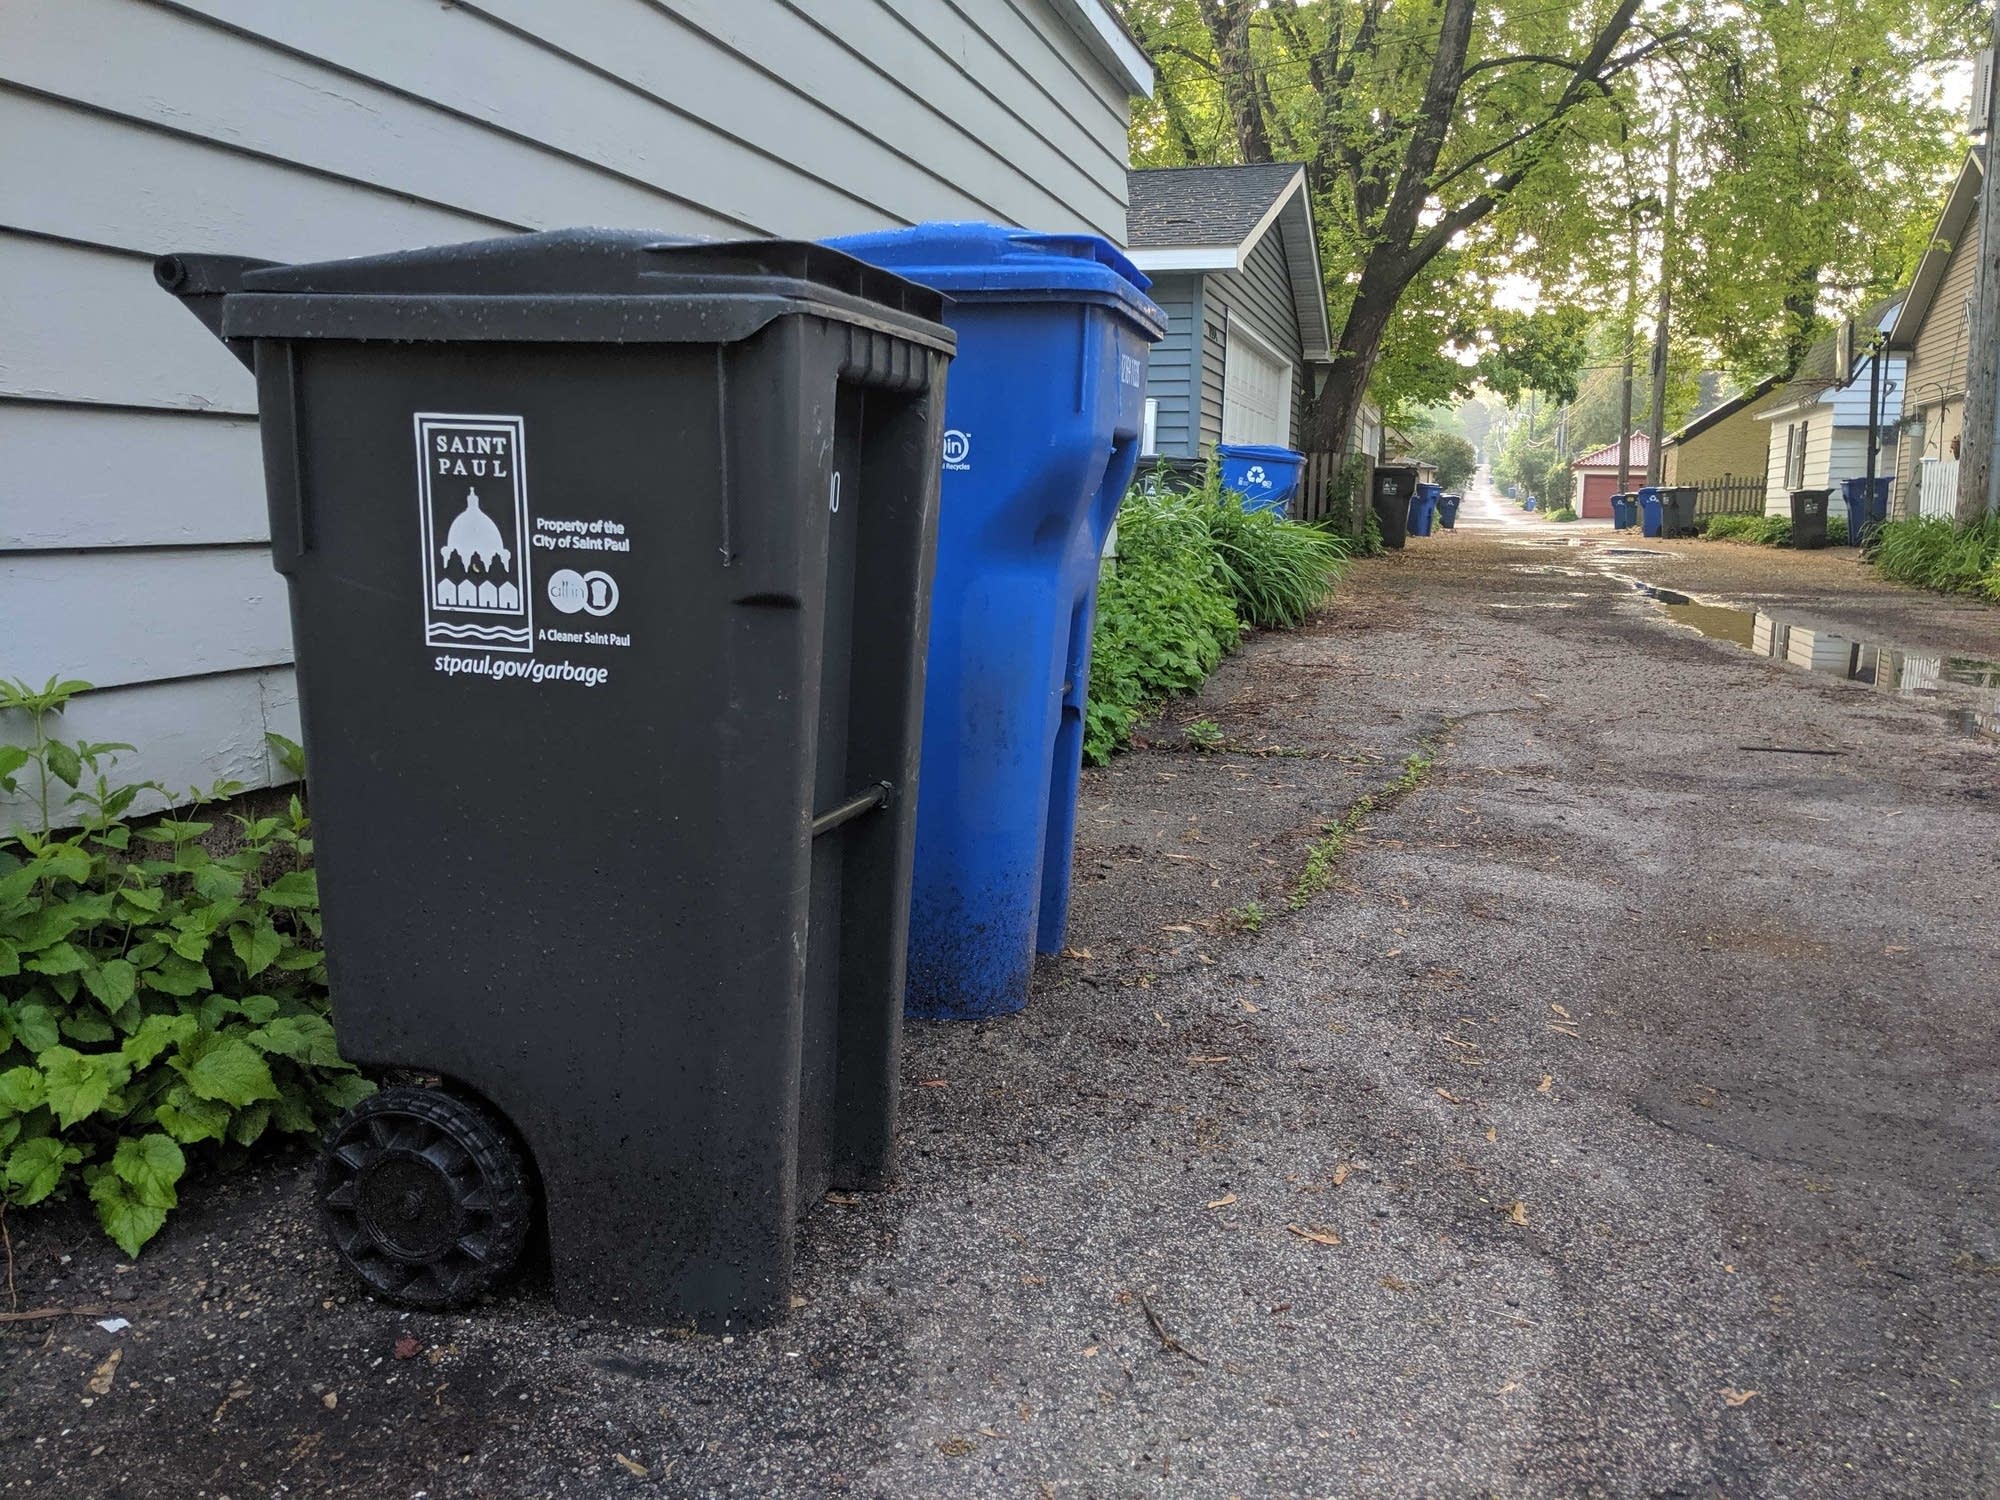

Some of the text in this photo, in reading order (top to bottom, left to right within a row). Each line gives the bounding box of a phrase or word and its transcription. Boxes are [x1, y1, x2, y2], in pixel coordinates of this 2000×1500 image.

[436, 435, 507, 455] SAINT
[438, 458, 507, 477] PAUL
[537, 518, 625, 535] Property of the
[533, 534, 630, 552] City of Saint Paul
[539, 629, 630, 647] A Cleaner Saint Paul
[434, 654, 608, 687] stpaul.gov/garbage
